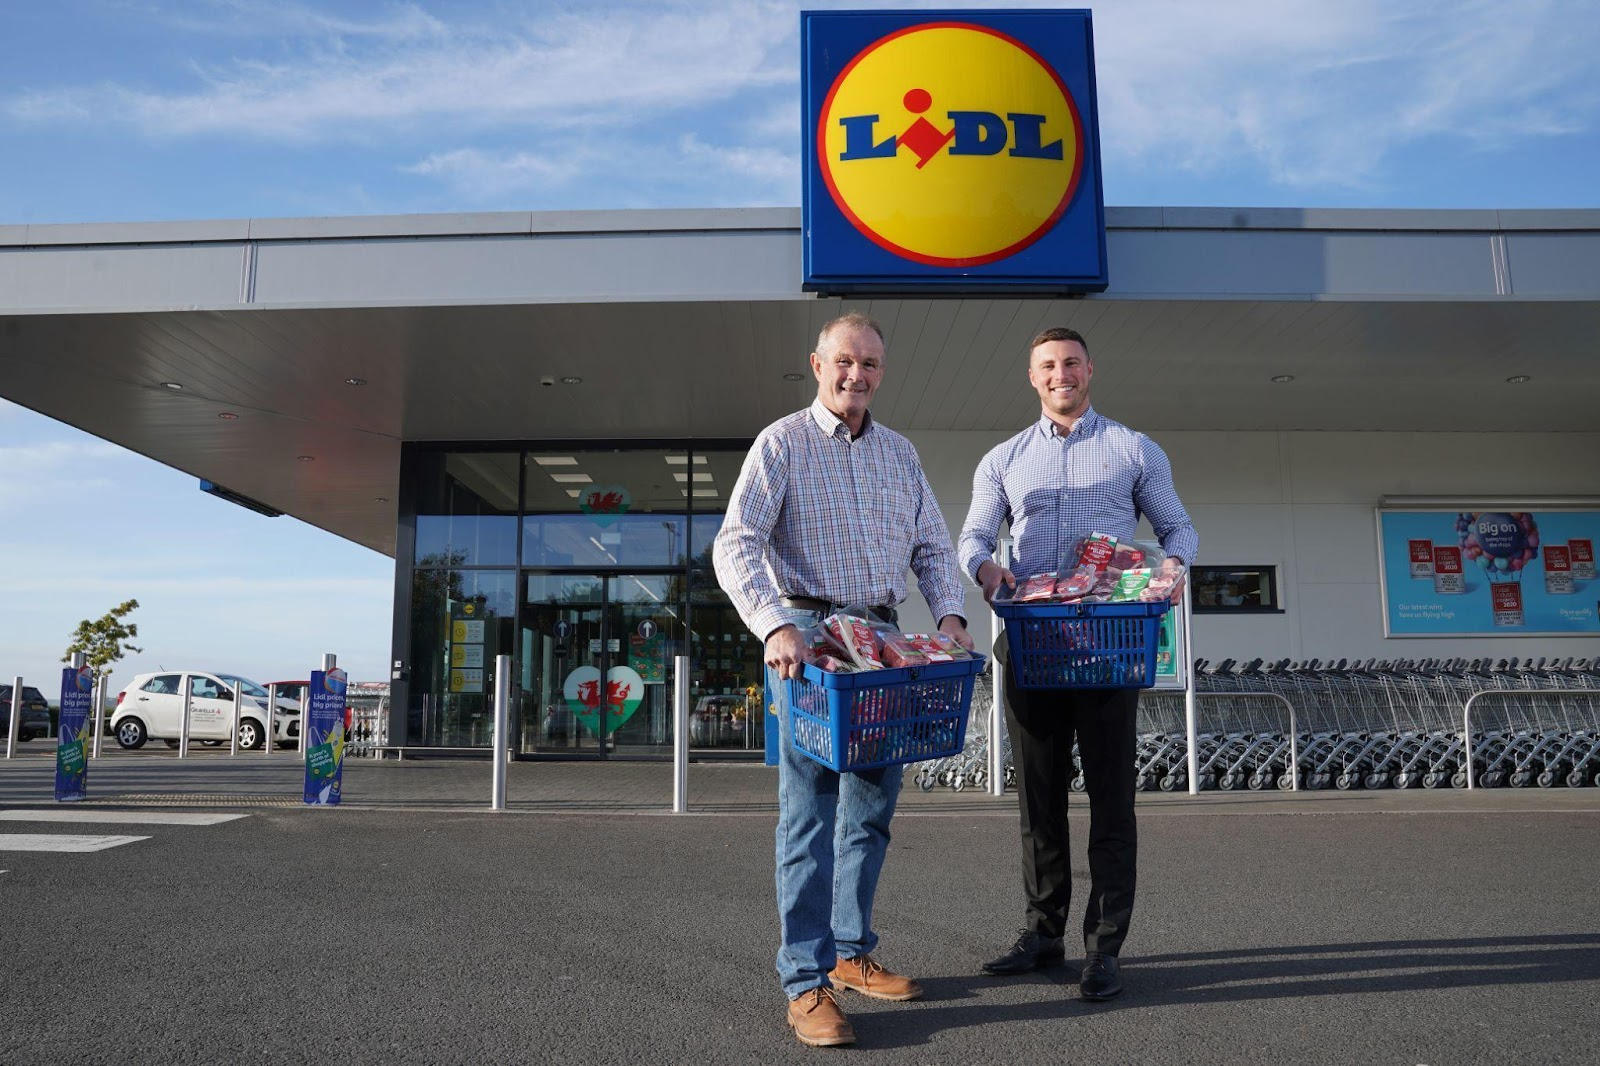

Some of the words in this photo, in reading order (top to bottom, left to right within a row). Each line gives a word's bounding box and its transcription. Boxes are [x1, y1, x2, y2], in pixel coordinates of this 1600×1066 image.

[1478, 521, 1499, 536] Big
[1500, 523, 1518, 533] on
[1422, 611, 1440, 620] flying
[1441, 611, 1455, 619] high
